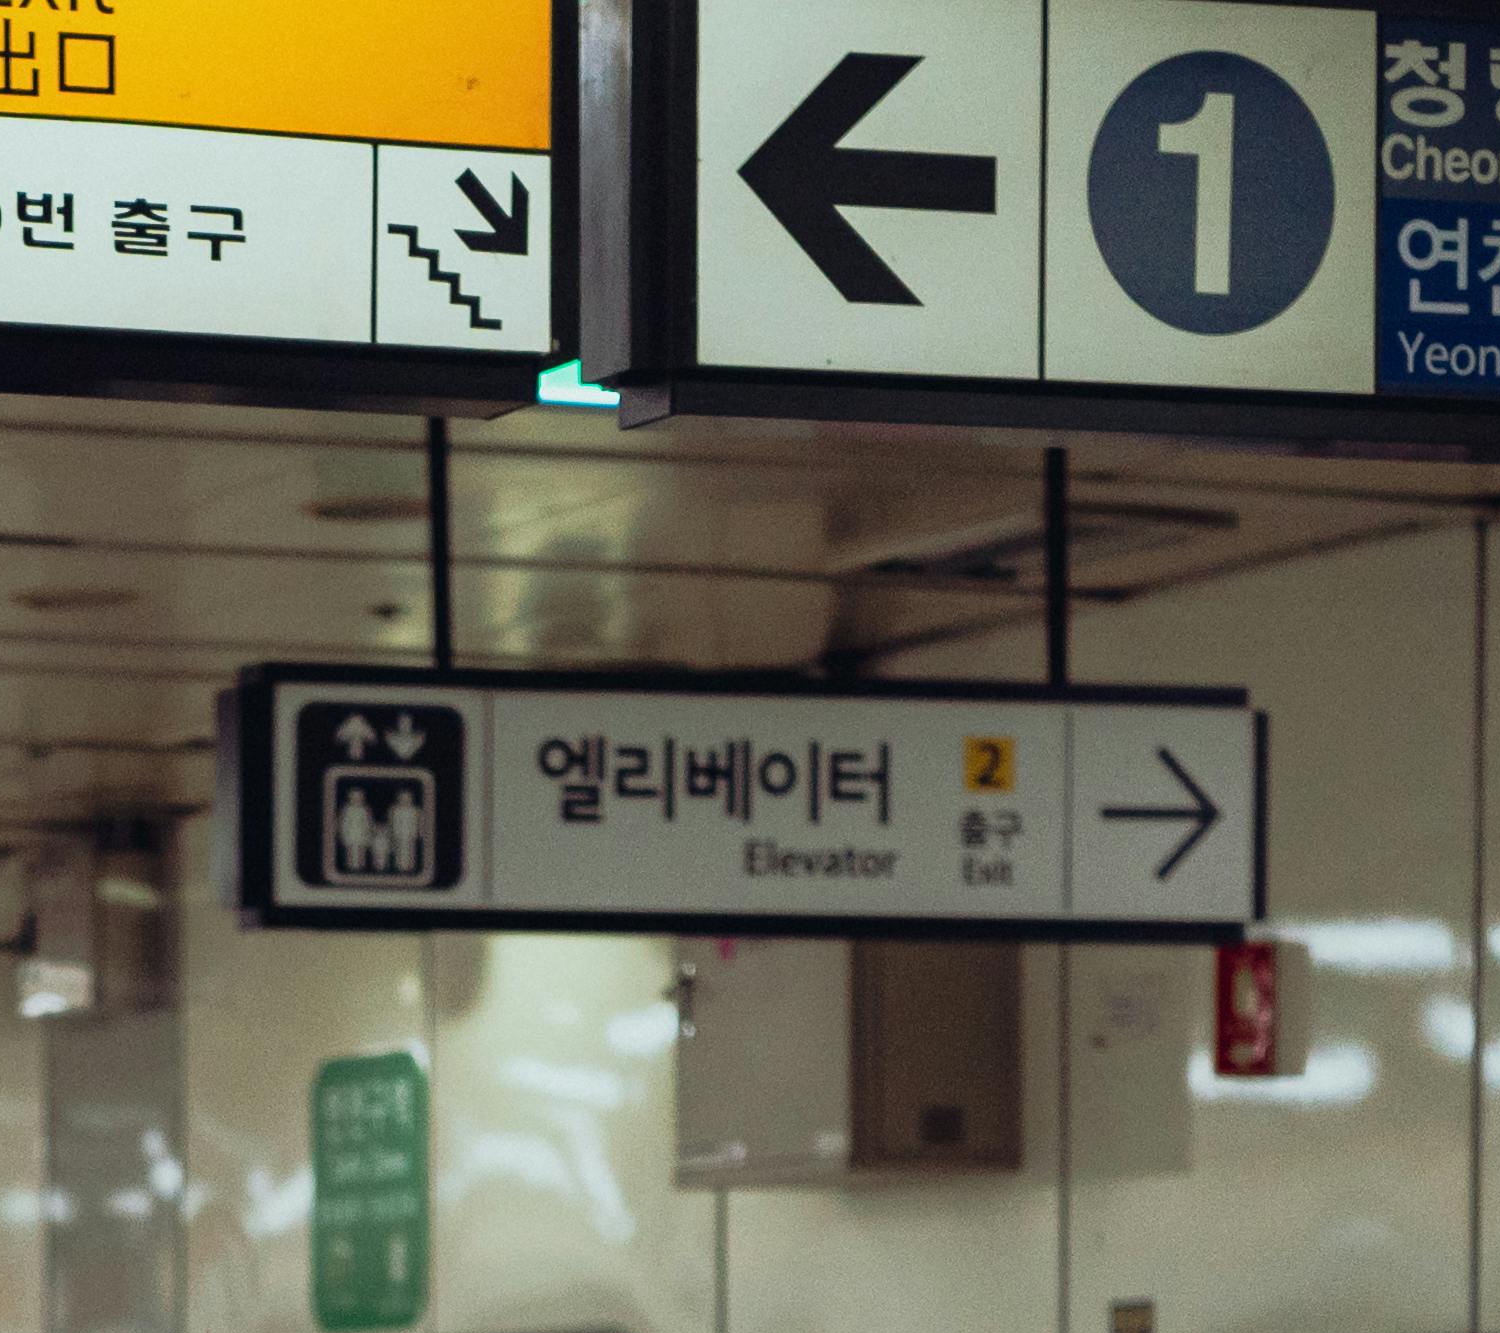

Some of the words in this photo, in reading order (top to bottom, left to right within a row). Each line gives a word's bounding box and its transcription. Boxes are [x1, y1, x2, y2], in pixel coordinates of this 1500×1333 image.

[1156, 91, 1236, 297] 1
[110, 197, 247, 262] 출구
[537, 732, 892, 826] 엘리베이터
[975, 740, 1004, 789] 2
[957, 807, 1024, 848] 출구
[742, 838, 900, 880] Elevator
[962, 853, 1014, 887] Exit
